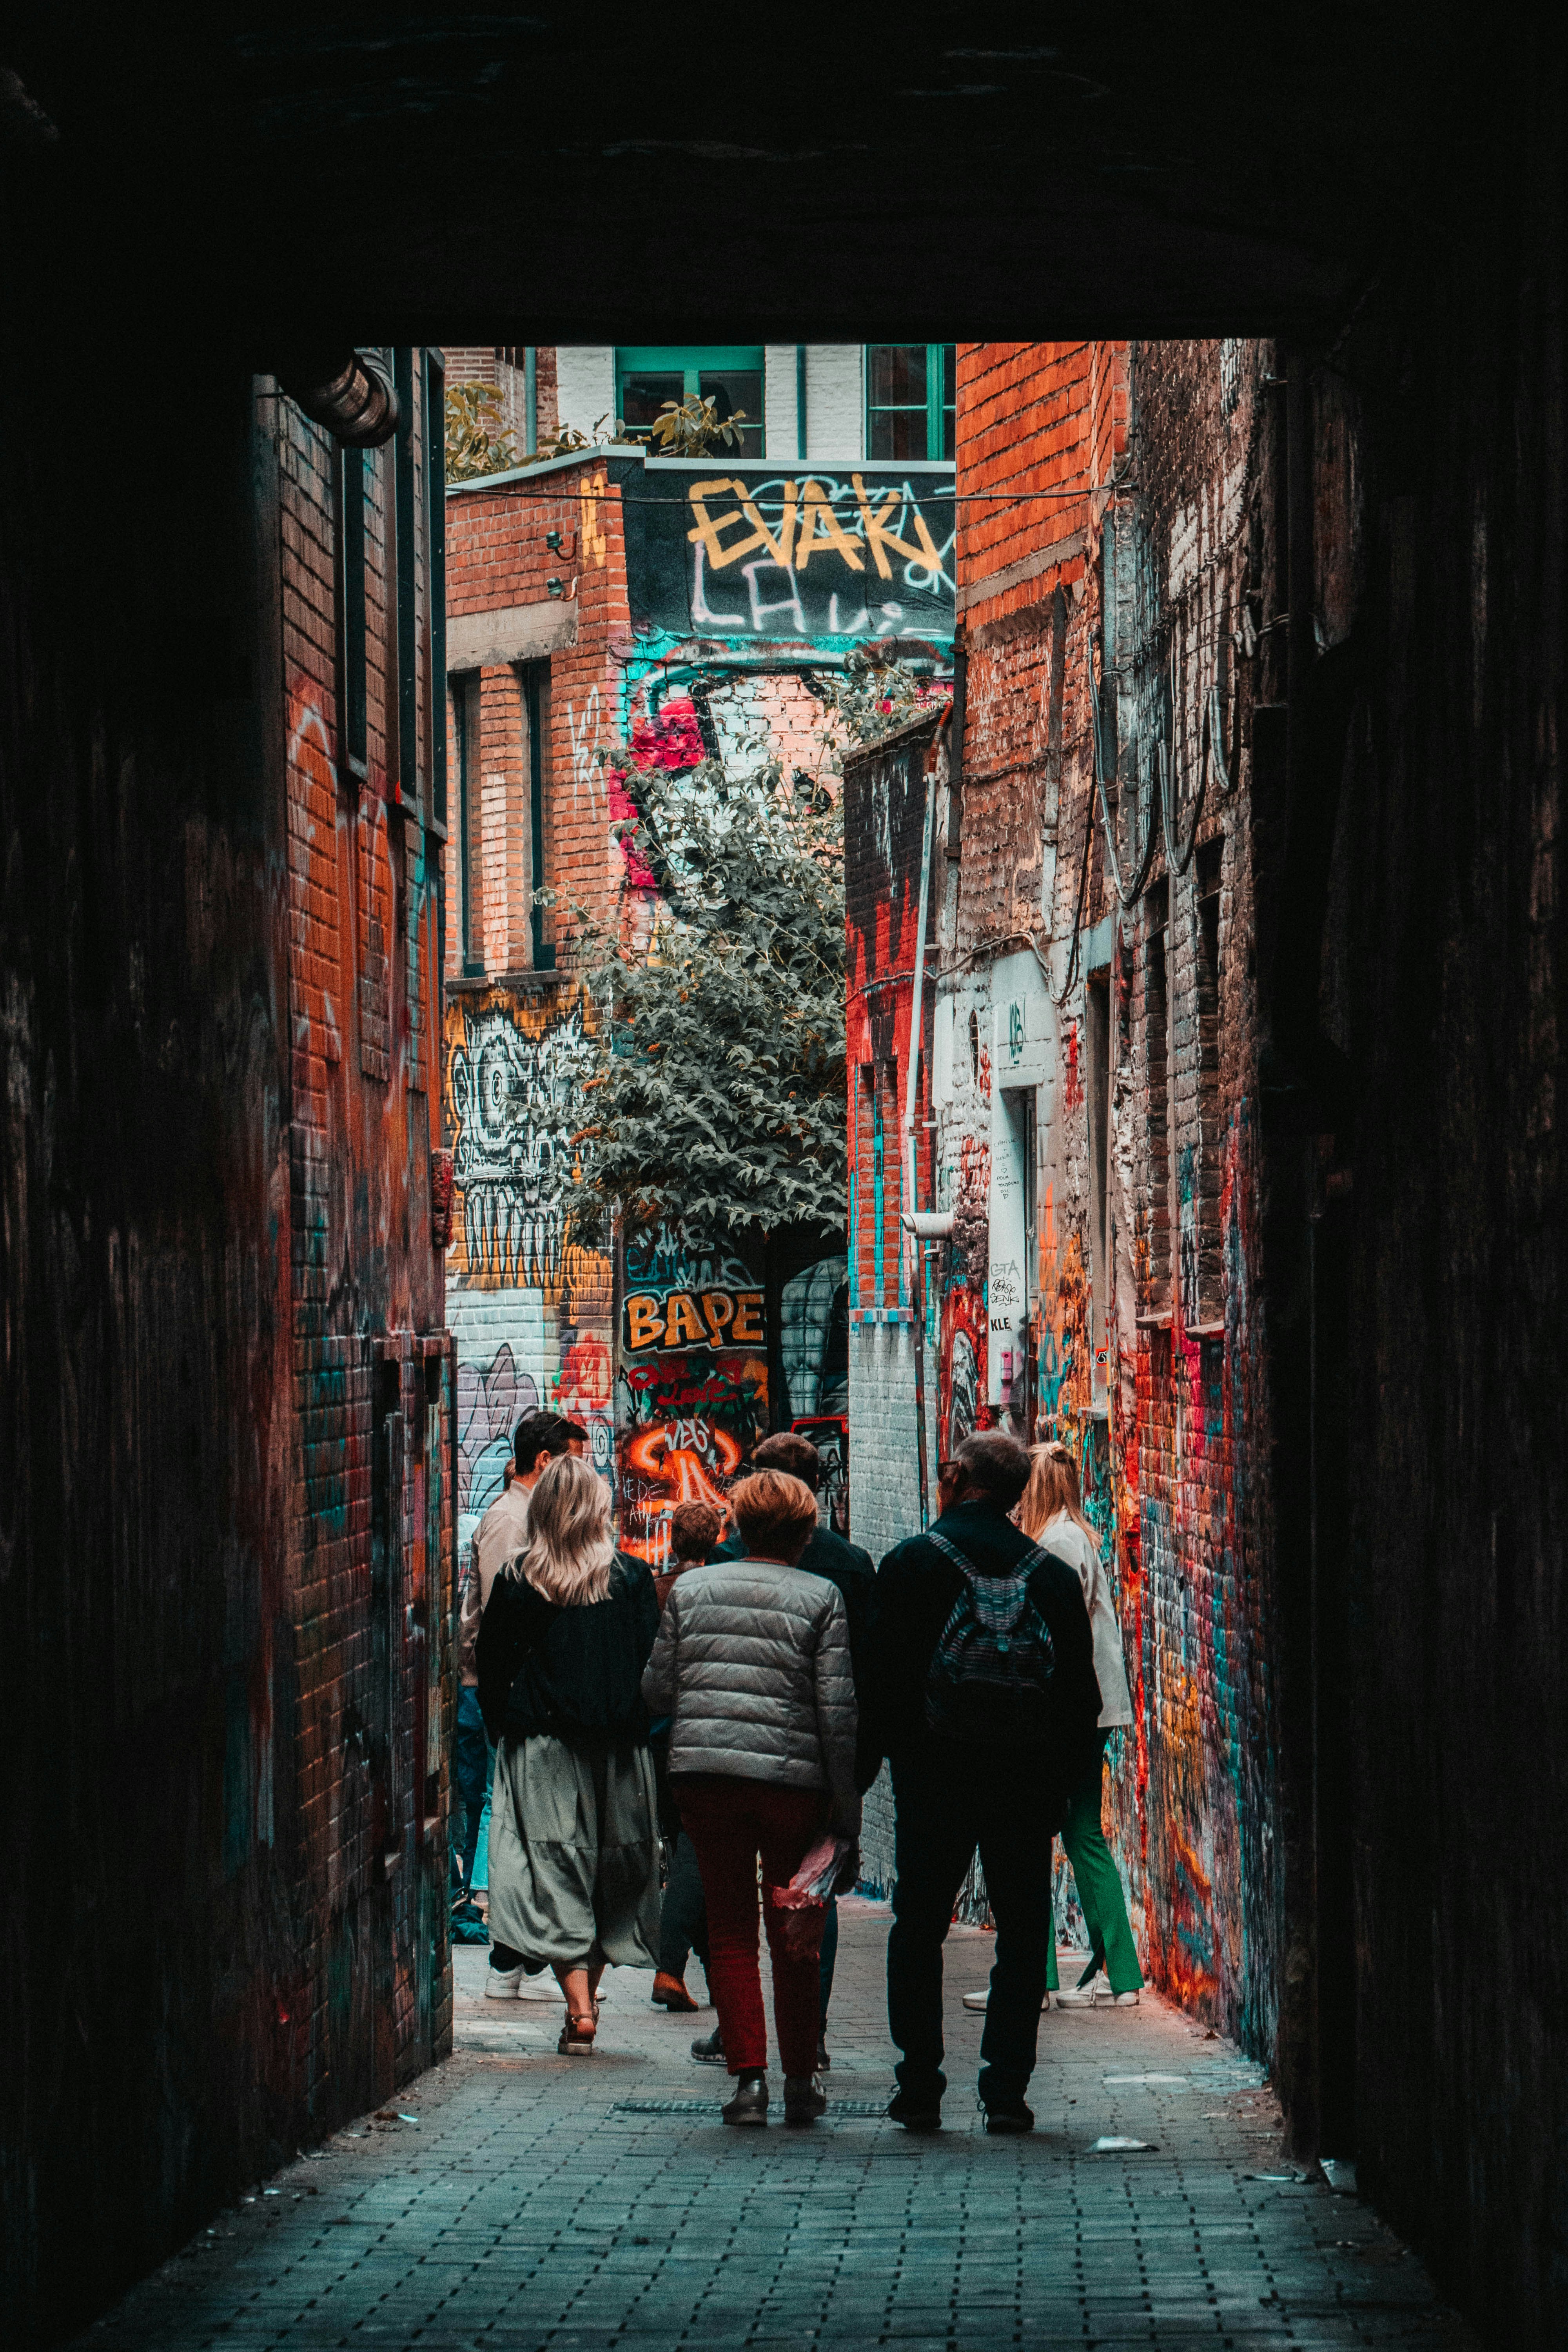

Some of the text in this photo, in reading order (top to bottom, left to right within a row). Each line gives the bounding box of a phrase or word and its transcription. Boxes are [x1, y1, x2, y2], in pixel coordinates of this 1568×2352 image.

[991, 1259, 1021, 1280] GTA
[626, 1292, 765, 1350] BAPE
[991, 1317, 1011, 1331] KLE
